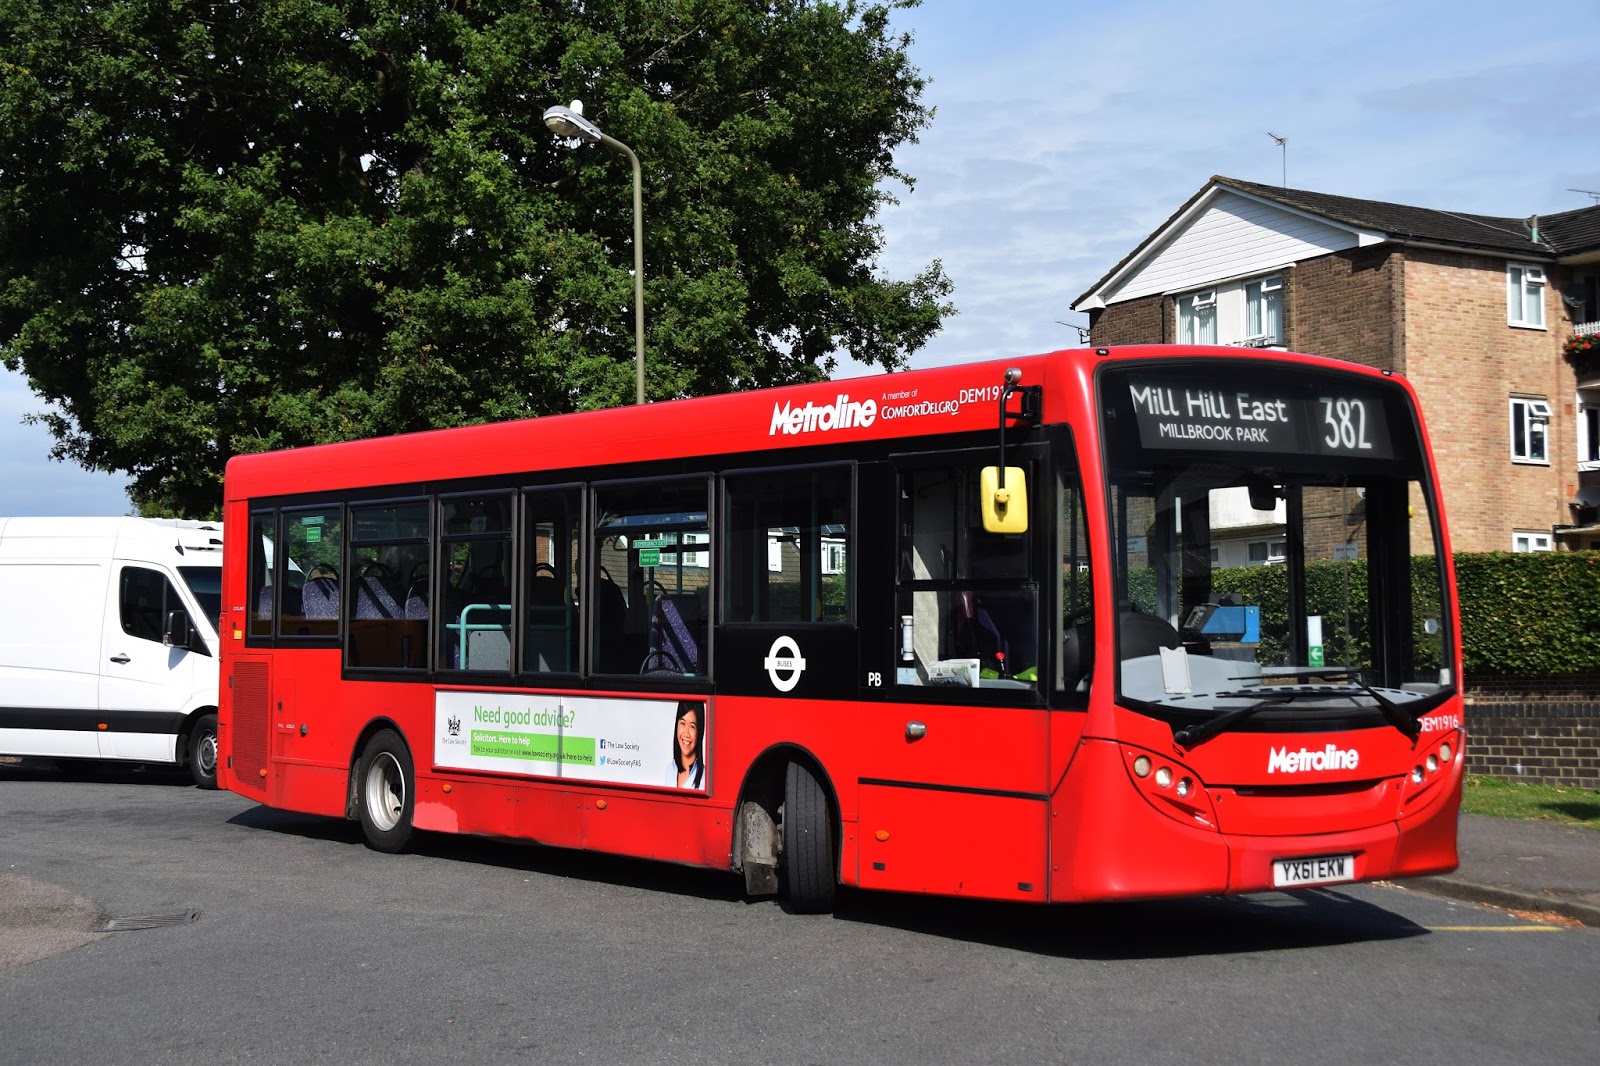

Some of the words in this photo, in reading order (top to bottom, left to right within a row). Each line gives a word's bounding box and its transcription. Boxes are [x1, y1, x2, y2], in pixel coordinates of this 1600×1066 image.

[882, 392, 887, 401] A
[888, 389, 910, 400] member
[1129, 385, 1180, 417] Mill
[1186, 389, 1231, 419] Hill
[1236, 393, 1288, 422] East
[769, 394, 877, 436] Metroline
[1319, 396, 1372, 449] 382
[1159, 422, 1234, 441] MILLBROOK
[1236, 427, 1269, 443] PARK
[868, 672, 882, 687] PB
[474, 705, 500, 723] Need
[504, 708, 530, 728] good
[534, 708, 575, 728] advice?
[1417, 714, 1459, 732] DEM1916
[498, 735, 510, 743] Here
[518, 736, 530, 747] help
[624, 742, 640, 752] Society
[1268, 744, 1359, 773] Metroline
[1283, 861, 1314, 880] YX61
[1318, 858, 1344, 878] EKW
